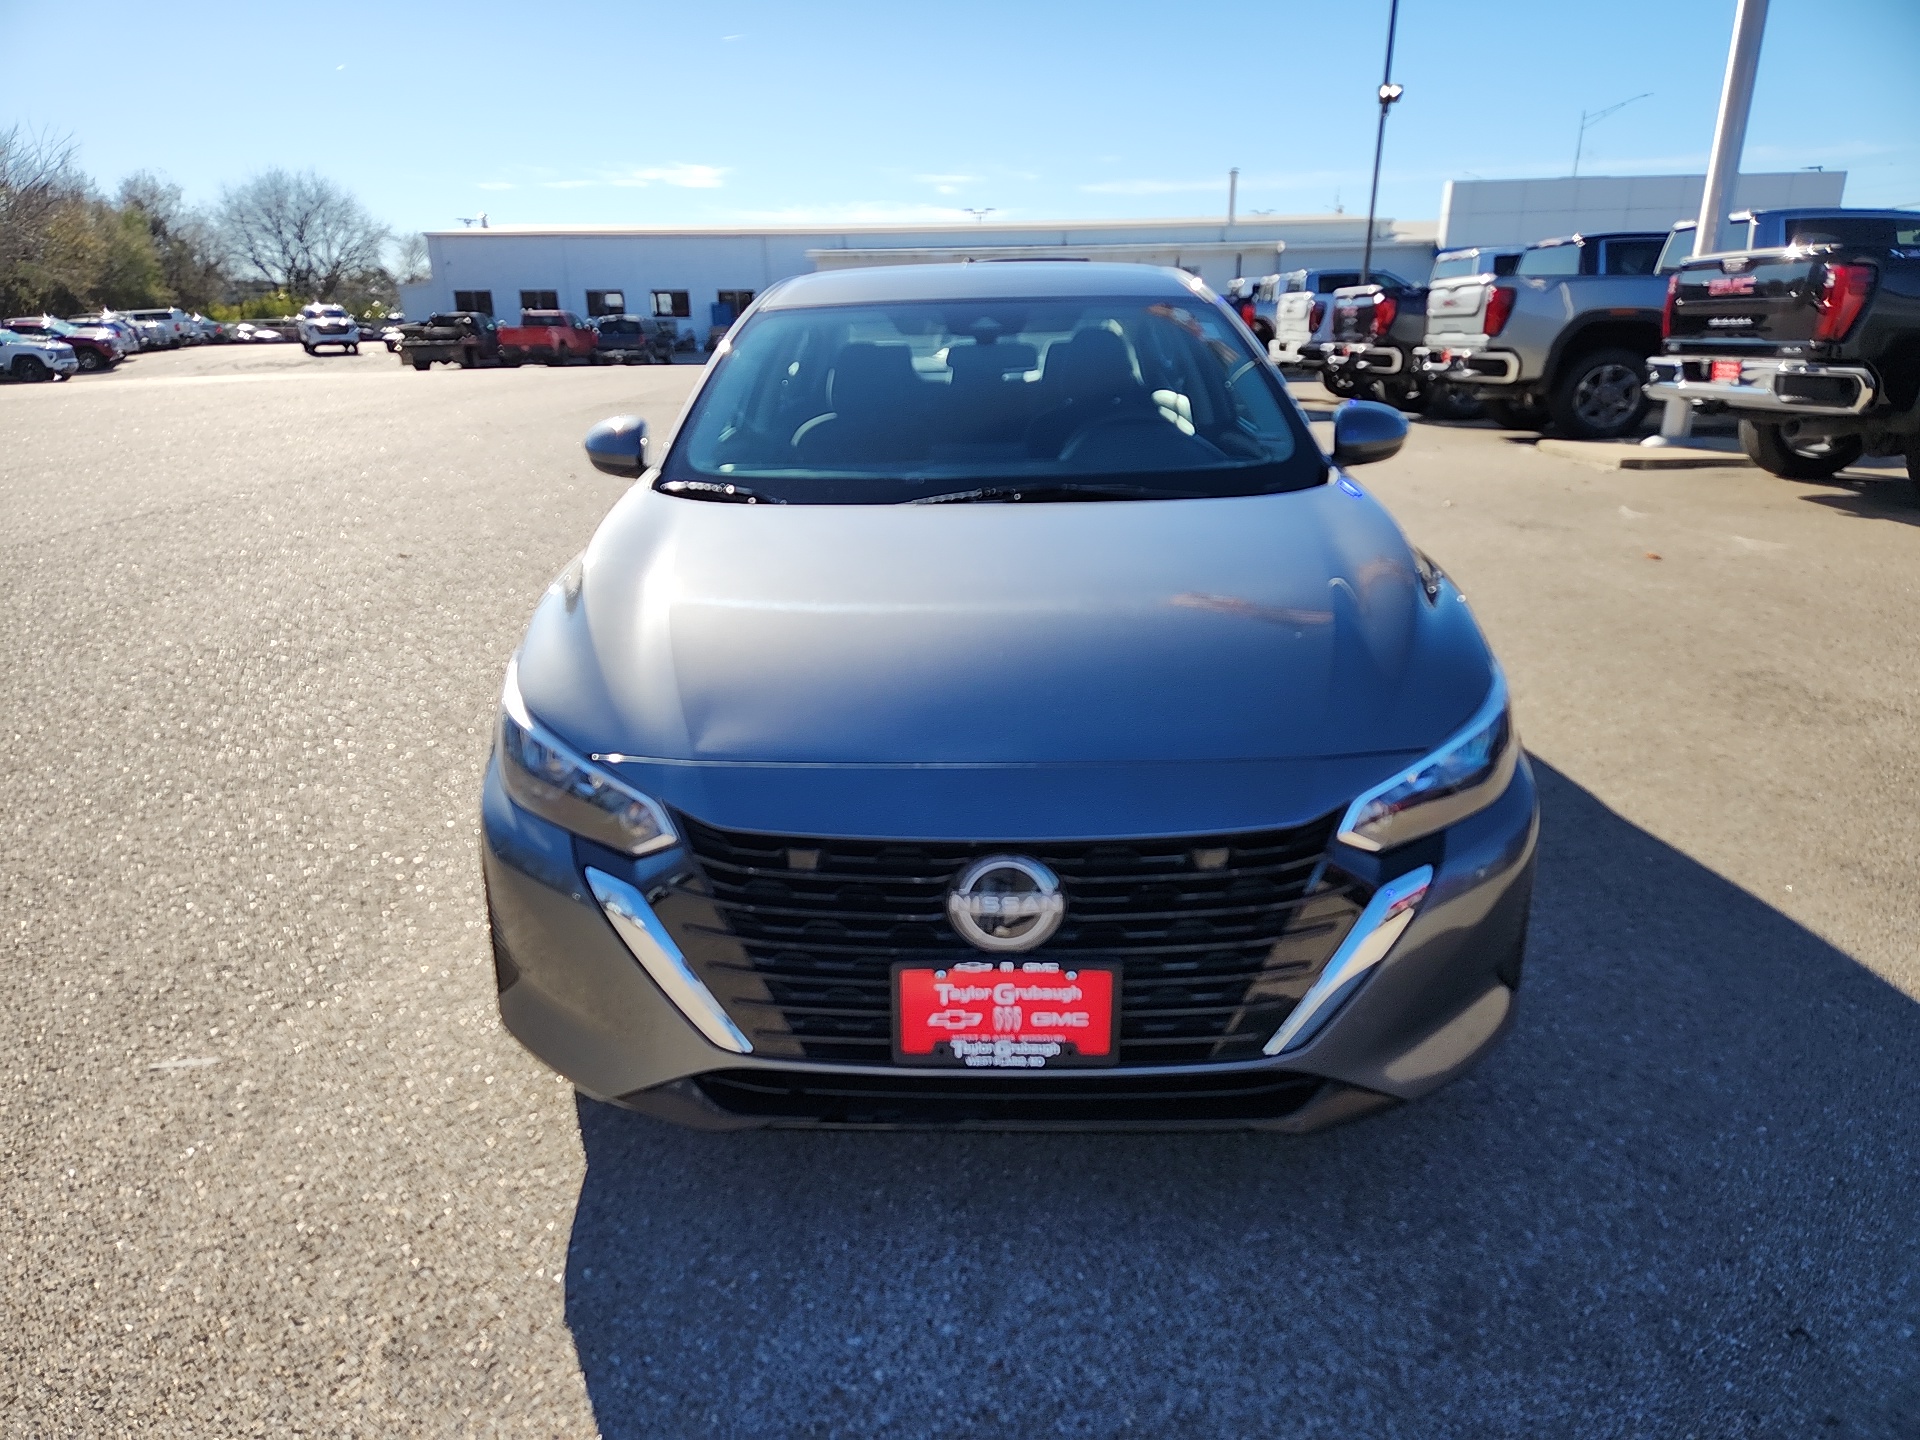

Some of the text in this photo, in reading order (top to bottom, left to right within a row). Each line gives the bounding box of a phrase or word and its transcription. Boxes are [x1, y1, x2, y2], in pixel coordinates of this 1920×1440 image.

[1708, 277, 1754, 296] GMC
[949, 894, 1063, 911] NISSAN
[934, 983, 1082, 1006] Taylor Grubaugh
[1031, 1012, 1090, 1027] GMC
